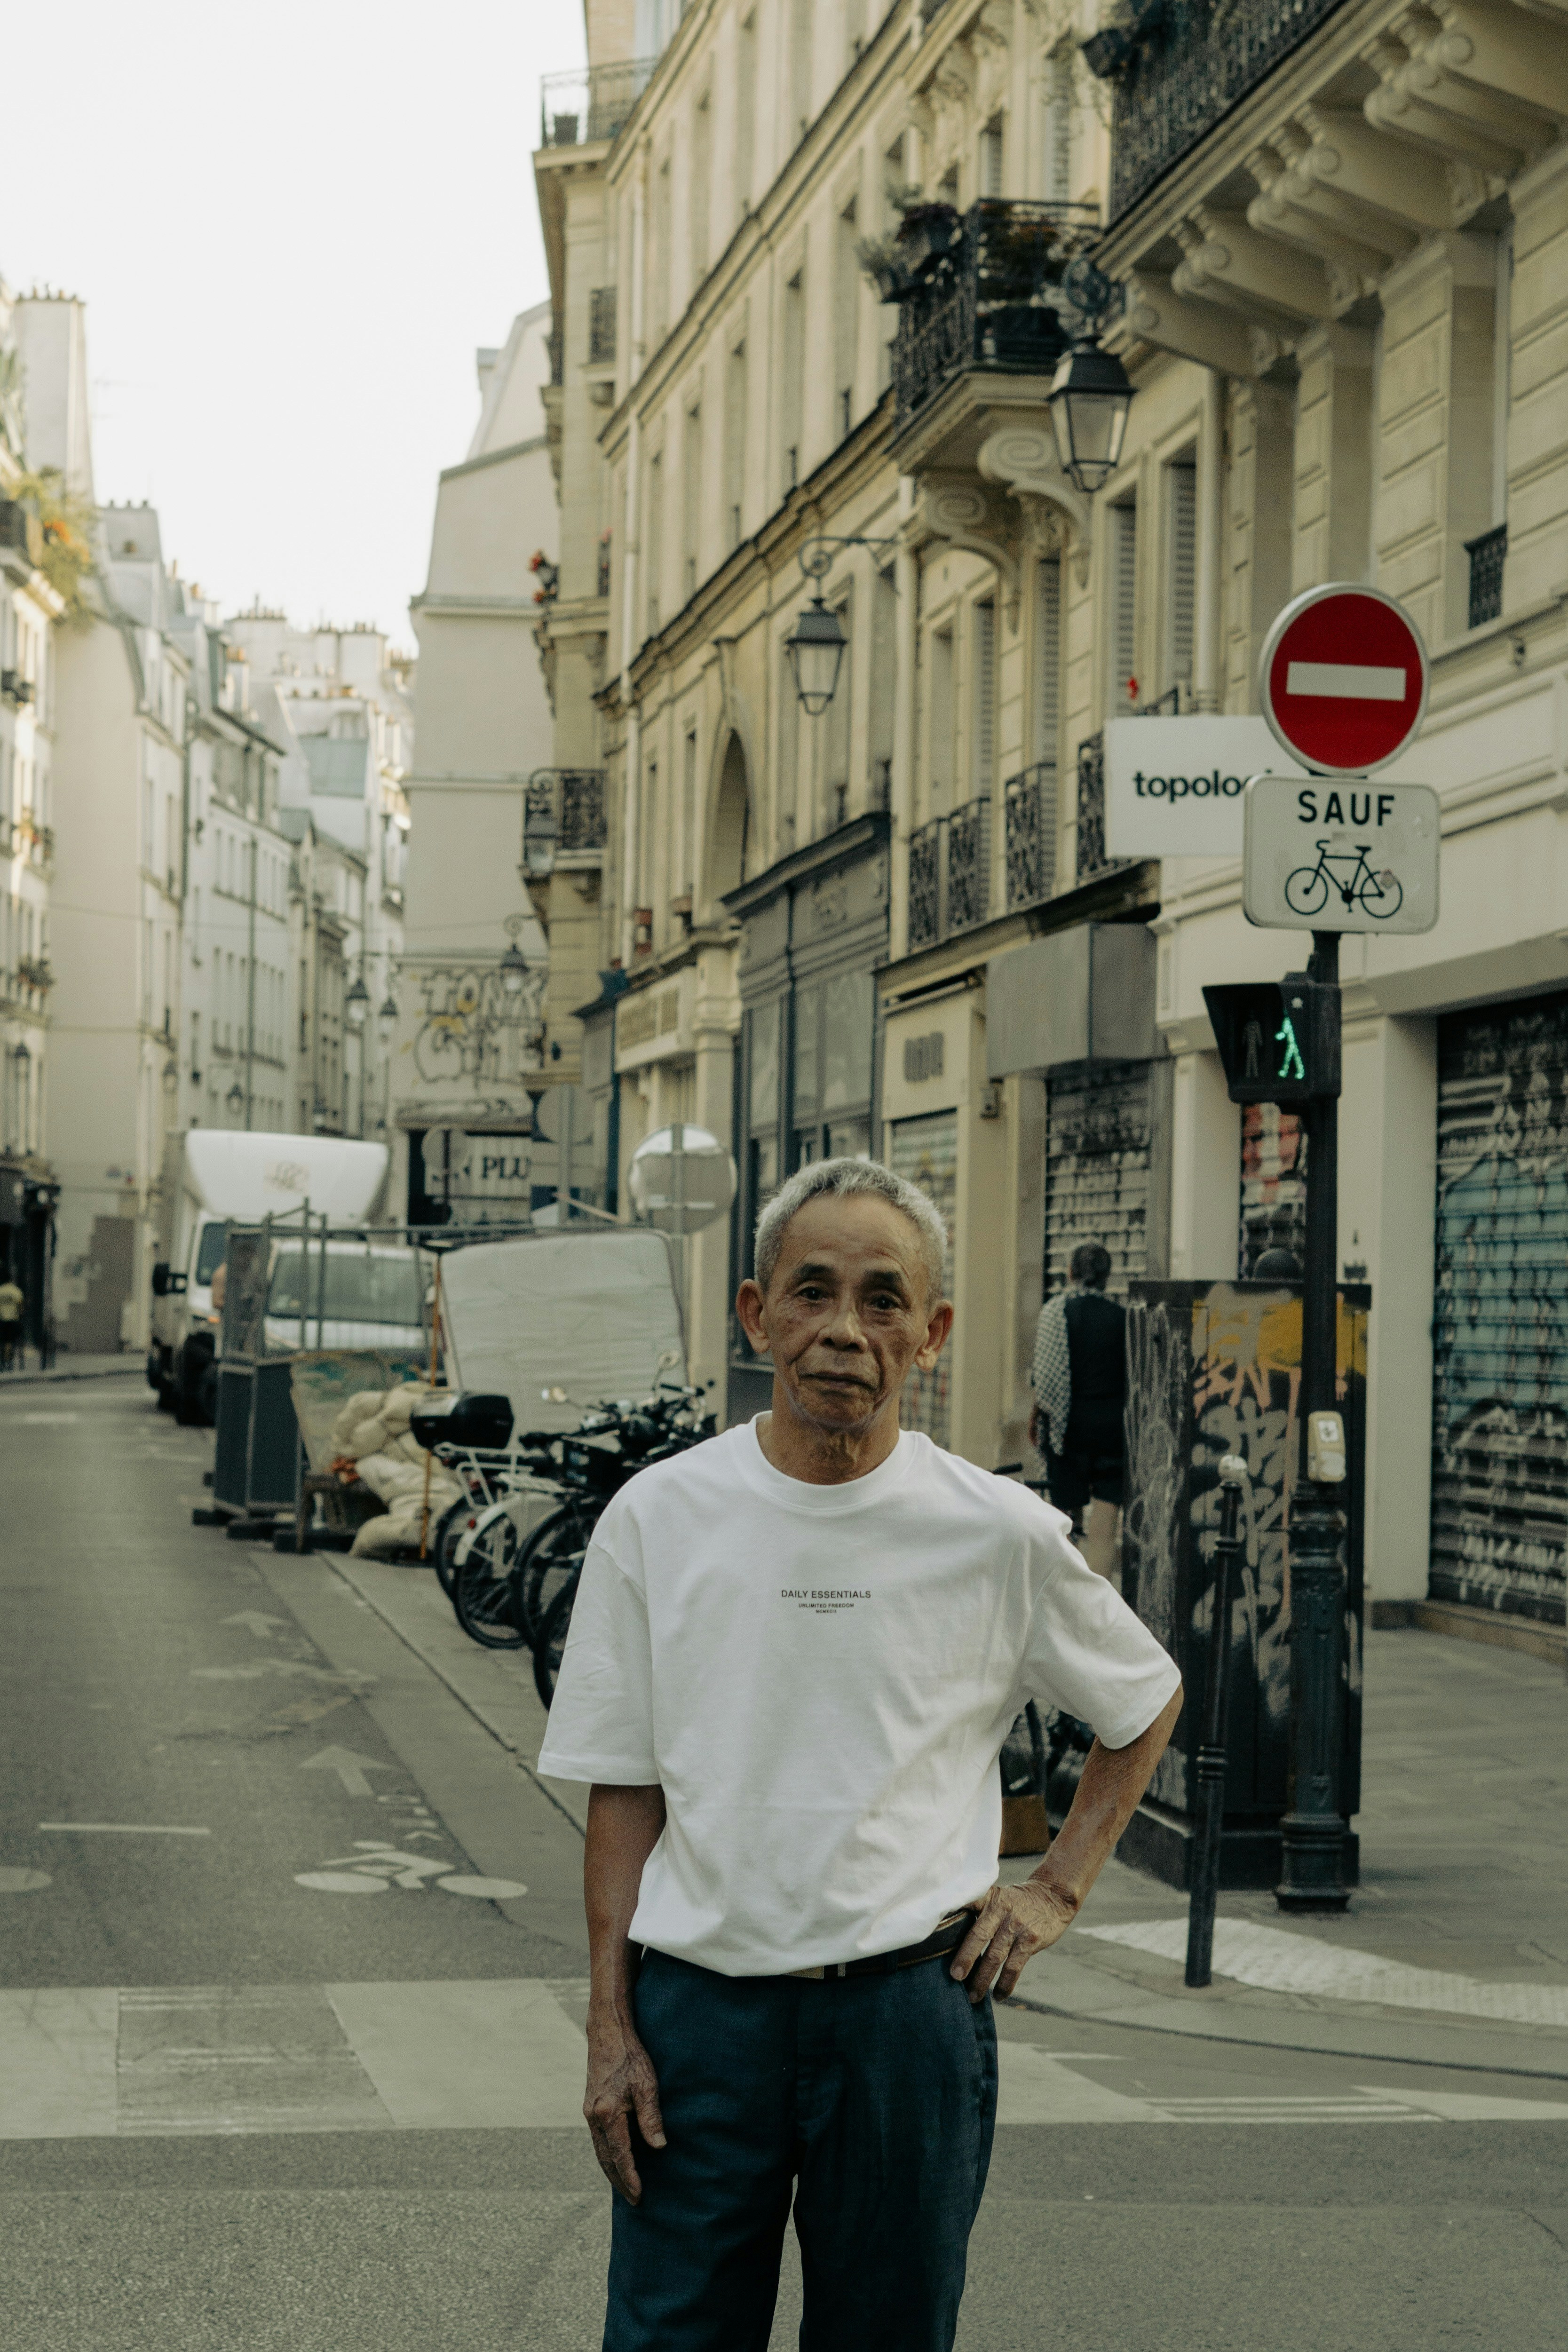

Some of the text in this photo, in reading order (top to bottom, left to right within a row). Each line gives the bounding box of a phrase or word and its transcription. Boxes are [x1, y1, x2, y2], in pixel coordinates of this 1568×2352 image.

[1133, 768, 1272, 803] topolo
[1298, 790, 1395, 826] SAUF
[781, 1590, 871, 1599] DAILY ESSENTIALS
